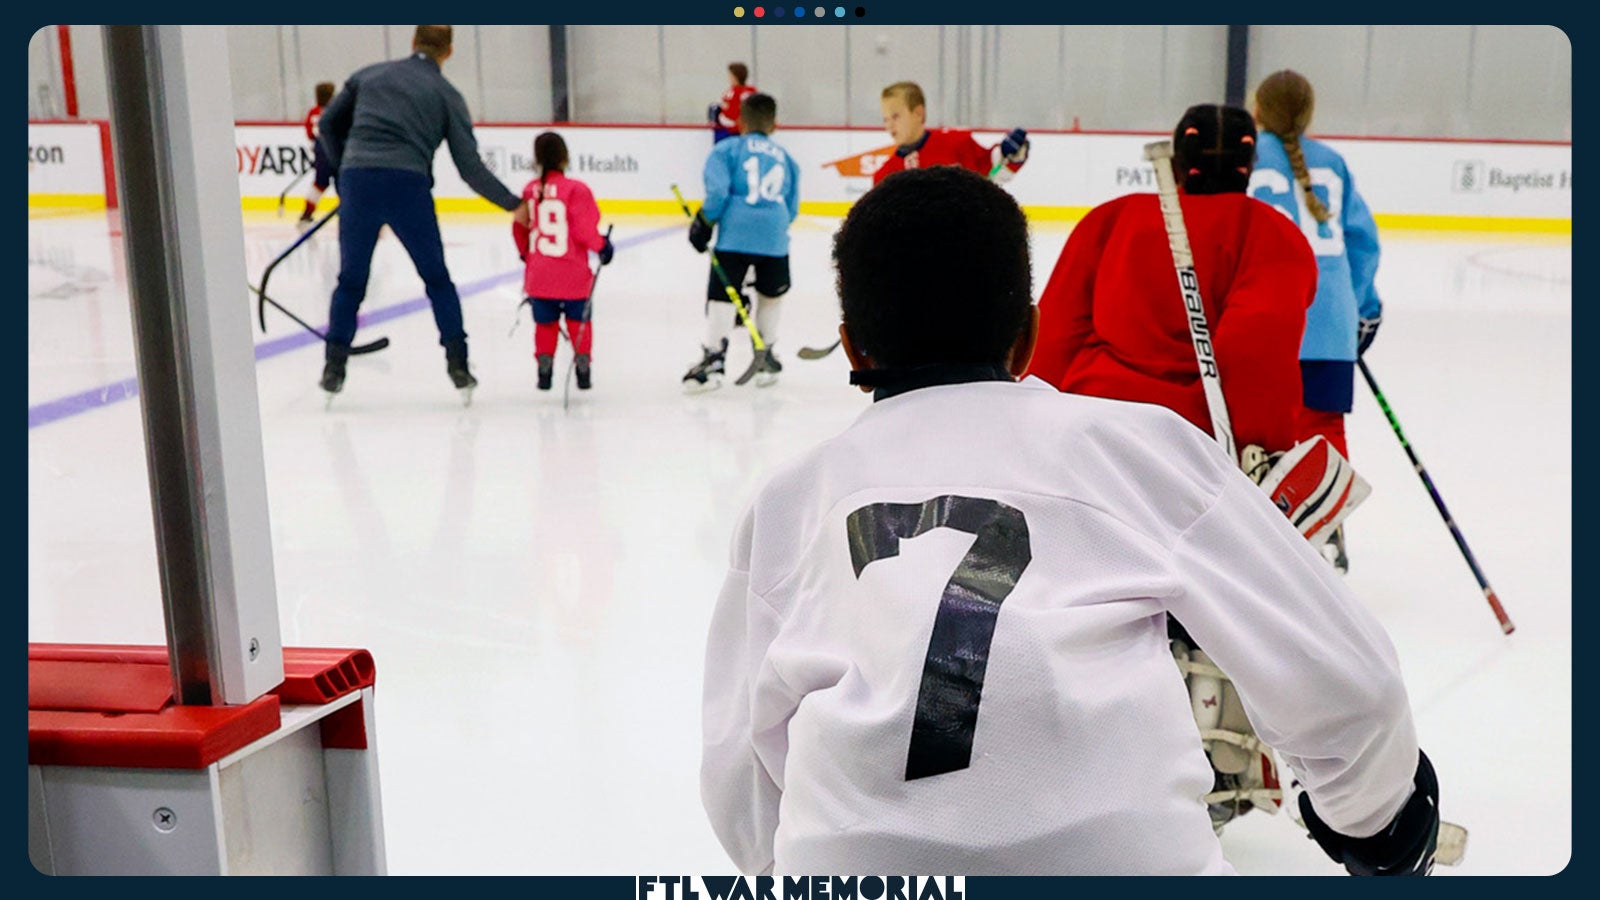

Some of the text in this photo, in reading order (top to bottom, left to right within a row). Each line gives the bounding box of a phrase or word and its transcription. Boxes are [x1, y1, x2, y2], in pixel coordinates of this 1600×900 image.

[579, 154, 639, 172] Health
[1489, 167, 1554, 192] Baptist
[847, 495, 1032, 781] 7
